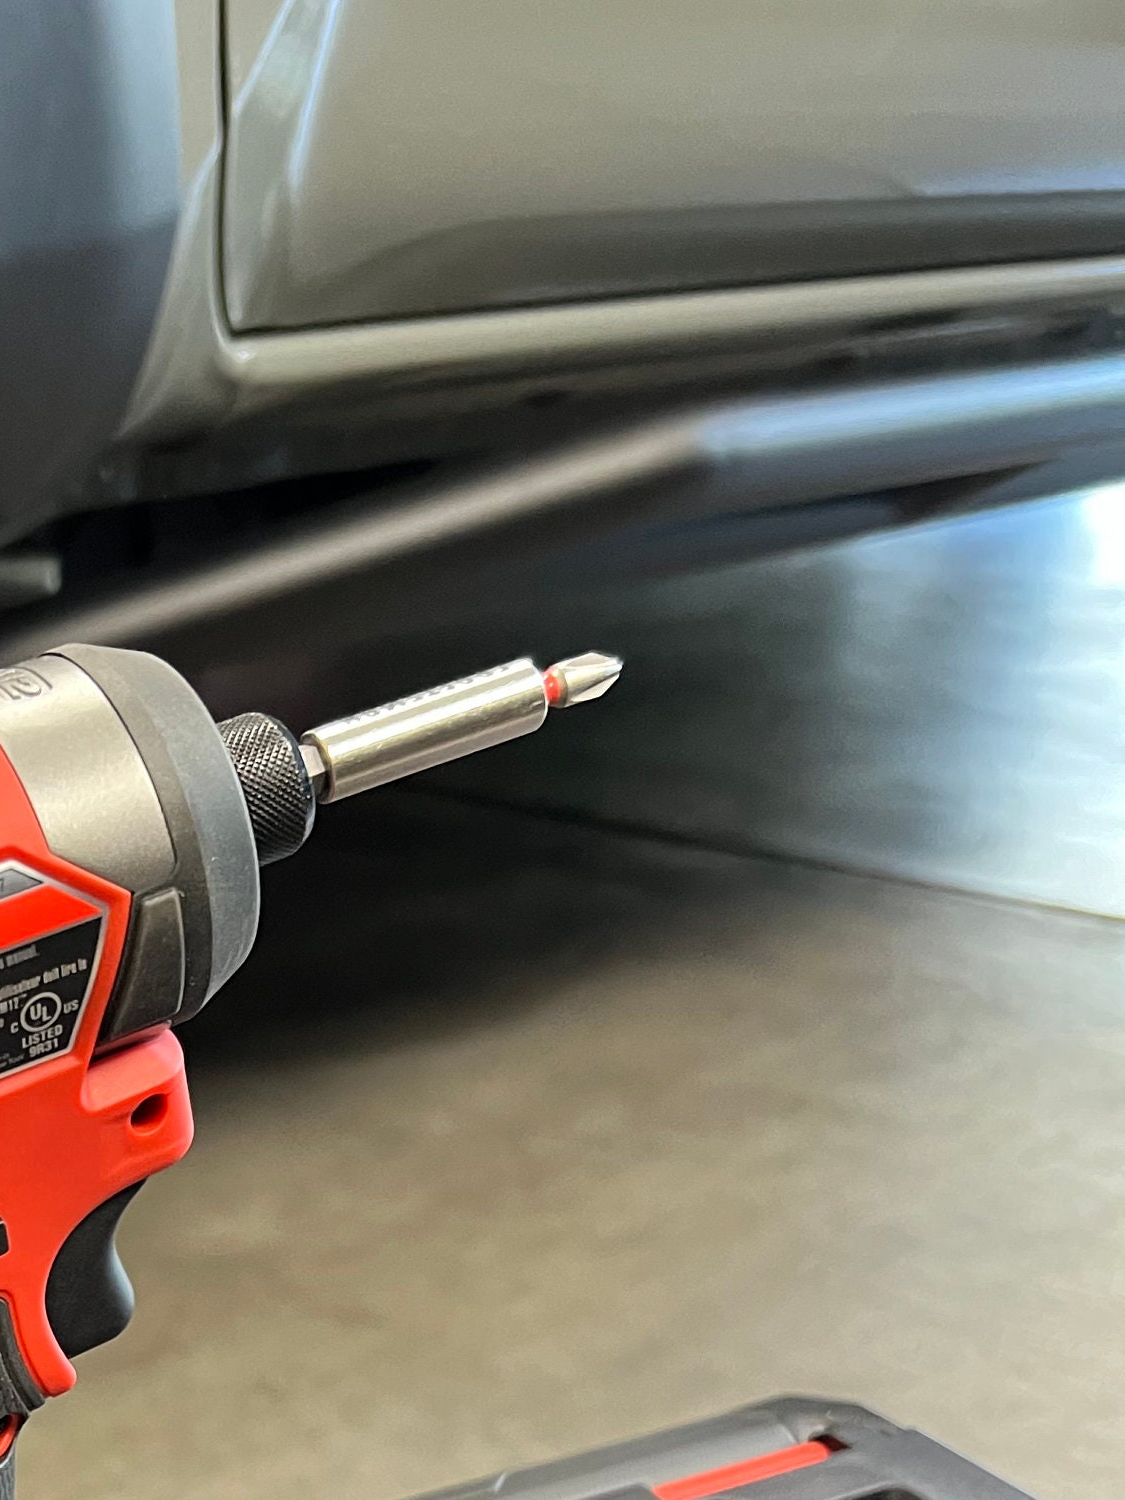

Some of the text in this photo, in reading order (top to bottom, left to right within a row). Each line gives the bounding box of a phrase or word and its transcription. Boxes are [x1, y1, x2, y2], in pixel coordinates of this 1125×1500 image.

[29, 1001, 52, 1022] UL
[63, 999, 79, 1014] US
[21, 1024, 63, 1049] LISTED
[28, 1038, 60, 1058] 9R31
